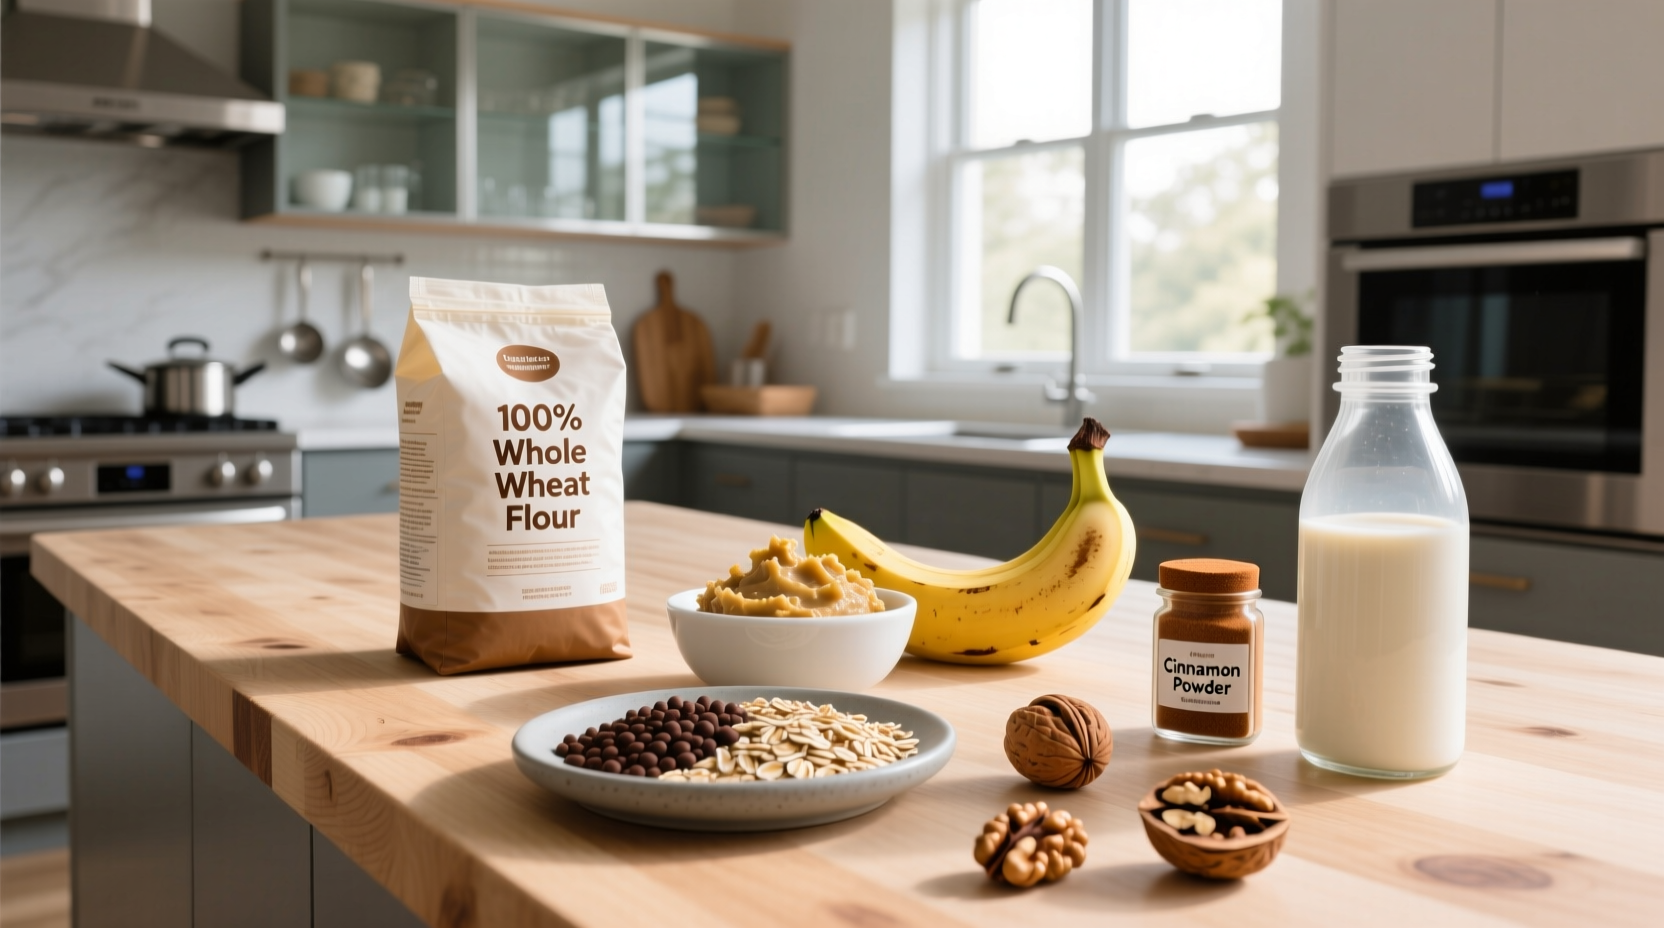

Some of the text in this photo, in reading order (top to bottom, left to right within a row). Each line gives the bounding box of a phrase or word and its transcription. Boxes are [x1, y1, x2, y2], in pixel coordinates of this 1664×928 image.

[497, 403, 582, 432] 100%
[493, 437, 587, 466] Whole
[494, 470, 590, 499] Wheat
[506, 503, 581, 531] Flour
[1163, 657, 1240, 677] Cinnamon
[1173, 676, 1232, 695] Powder
